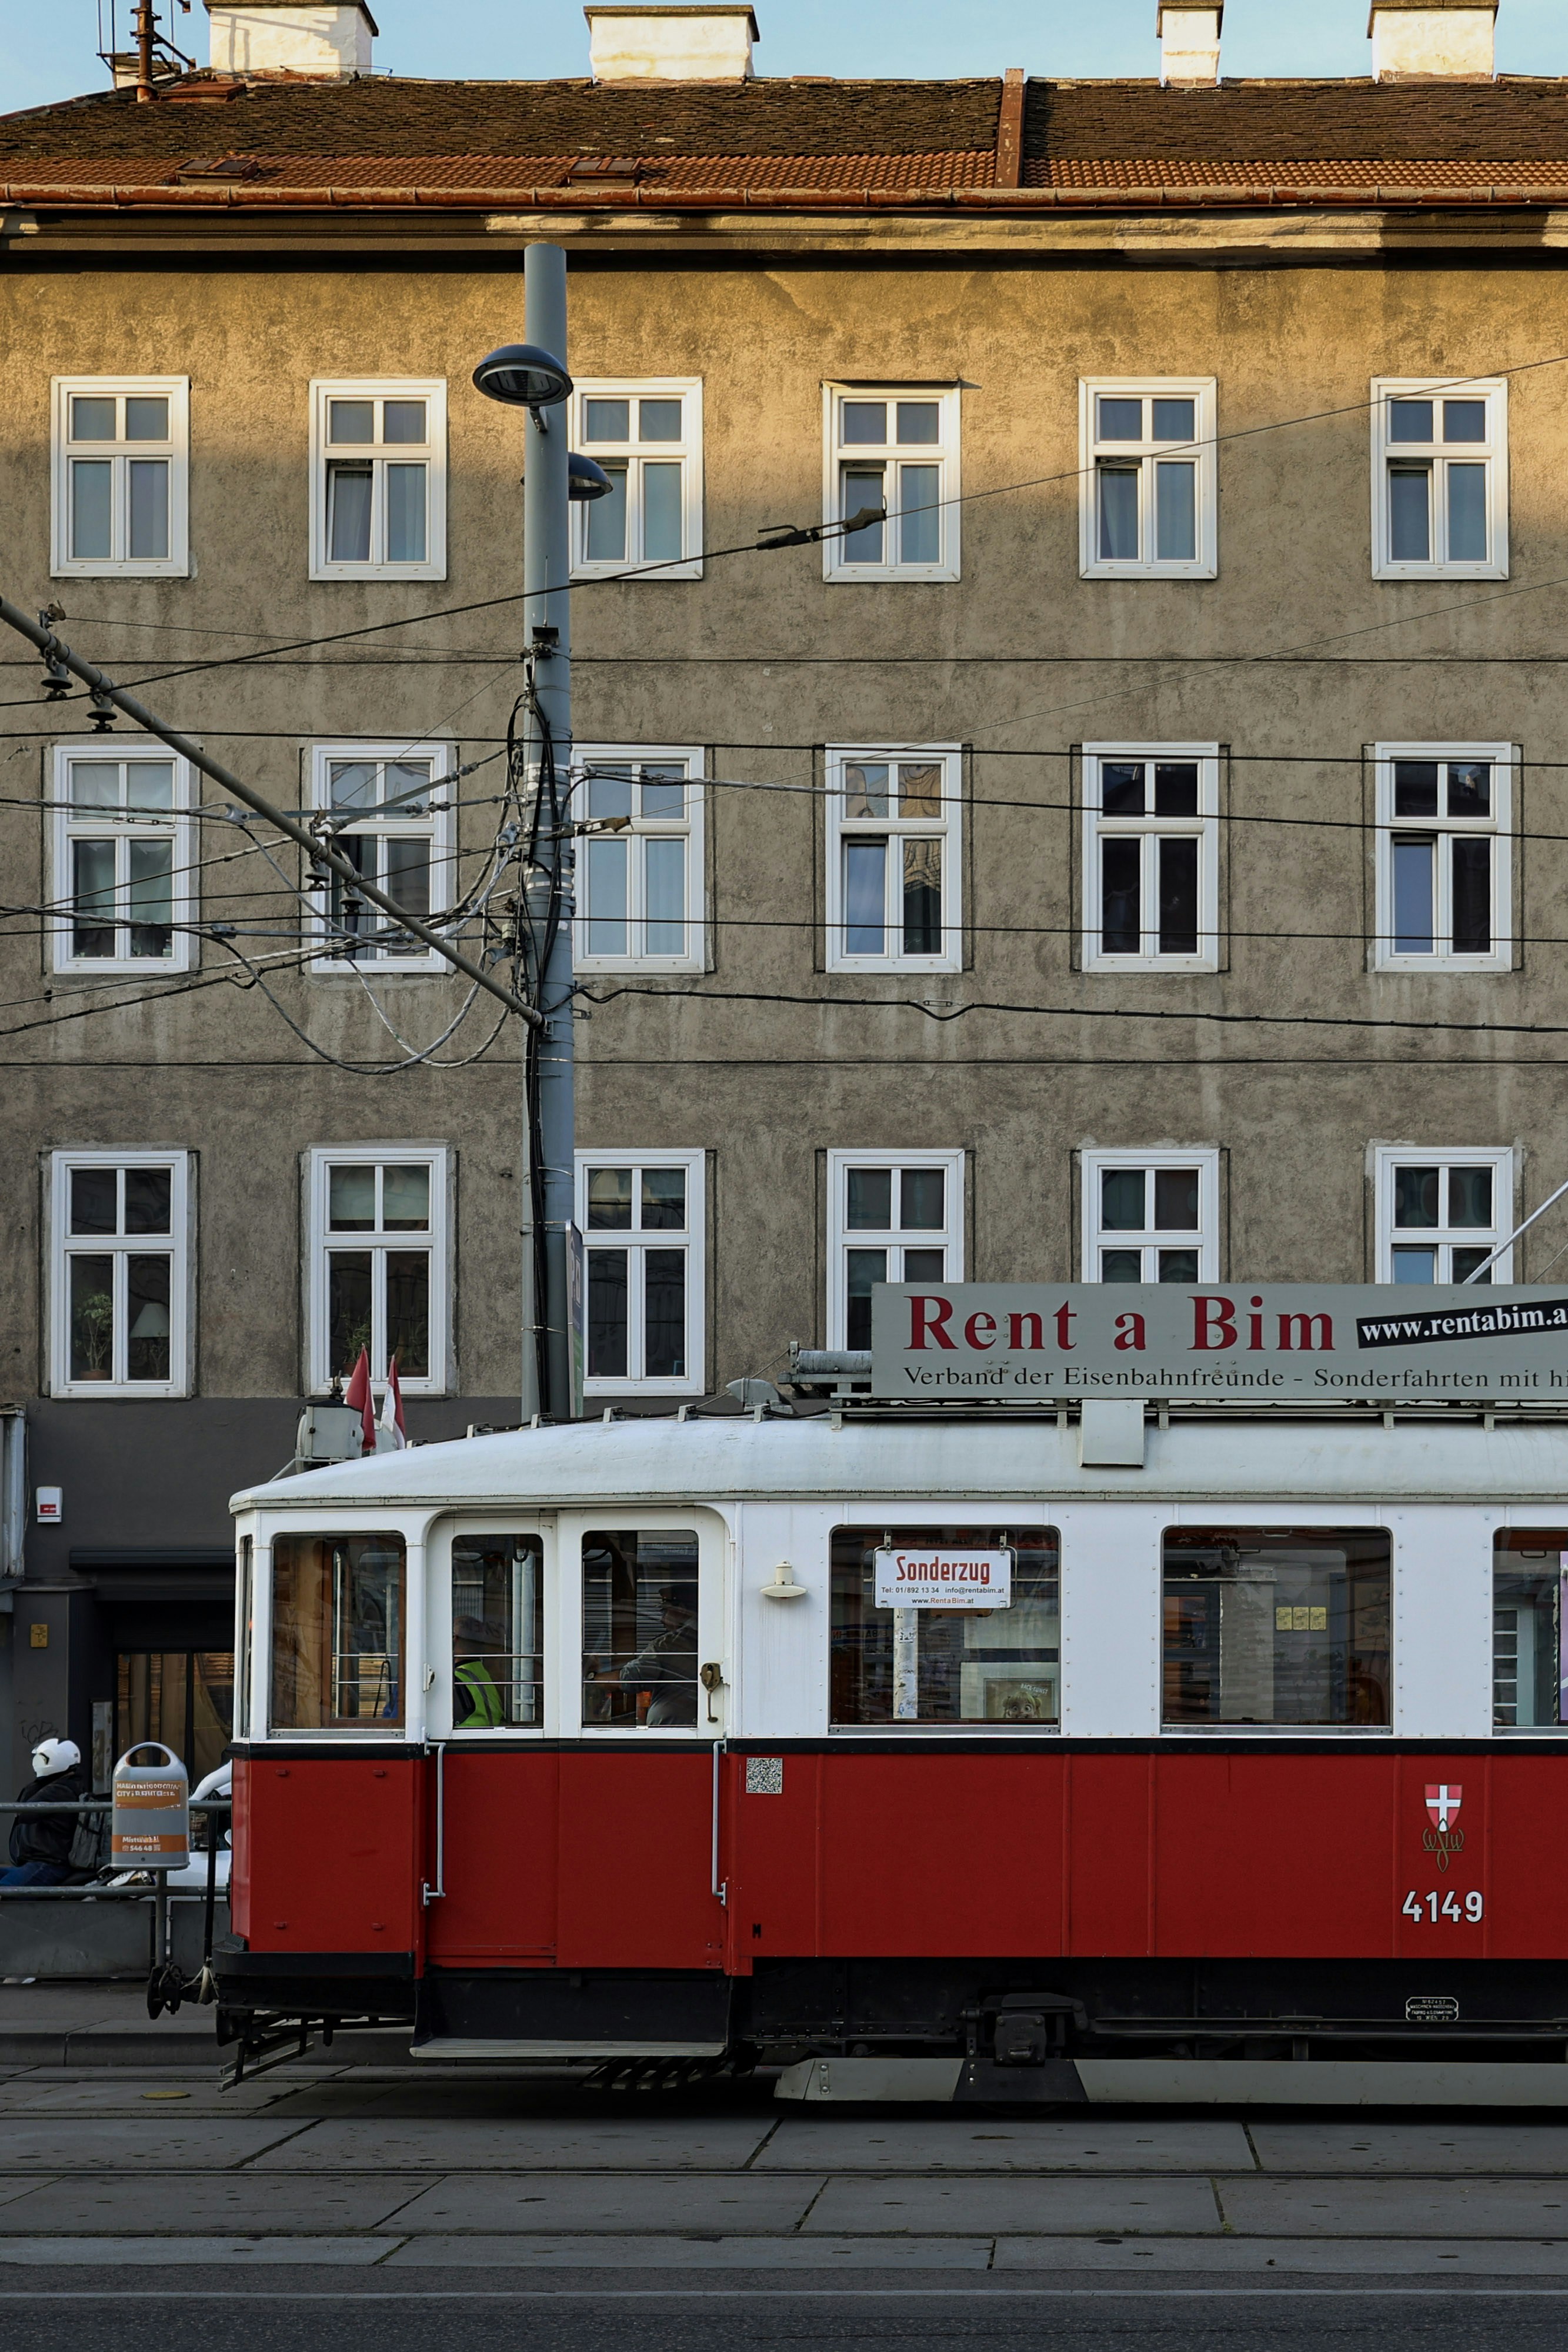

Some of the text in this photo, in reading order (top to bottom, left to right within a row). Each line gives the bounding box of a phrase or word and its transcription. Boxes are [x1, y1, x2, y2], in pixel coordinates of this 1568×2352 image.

[903, 1296, 1336, 1350] Rent a Bim
[1362, 1305, 1568, 1342] www.rentabim.a
[903, 1366, 1005, 1385] Verband
[1015, 1367, 1054, 1385] der
[1064, 1367, 1285, 1386] Eisenbahnfreunde
[1314, 1369, 1489, 1387] Sonderfahrten
[1500, 1369, 1539, 1387] mit
[896, 1556, 990, 1585] Sonderzug
[945, 1586, 1005, 1595] info@rentabim.at
[1402, 1891, 1484, 1923] 4149
